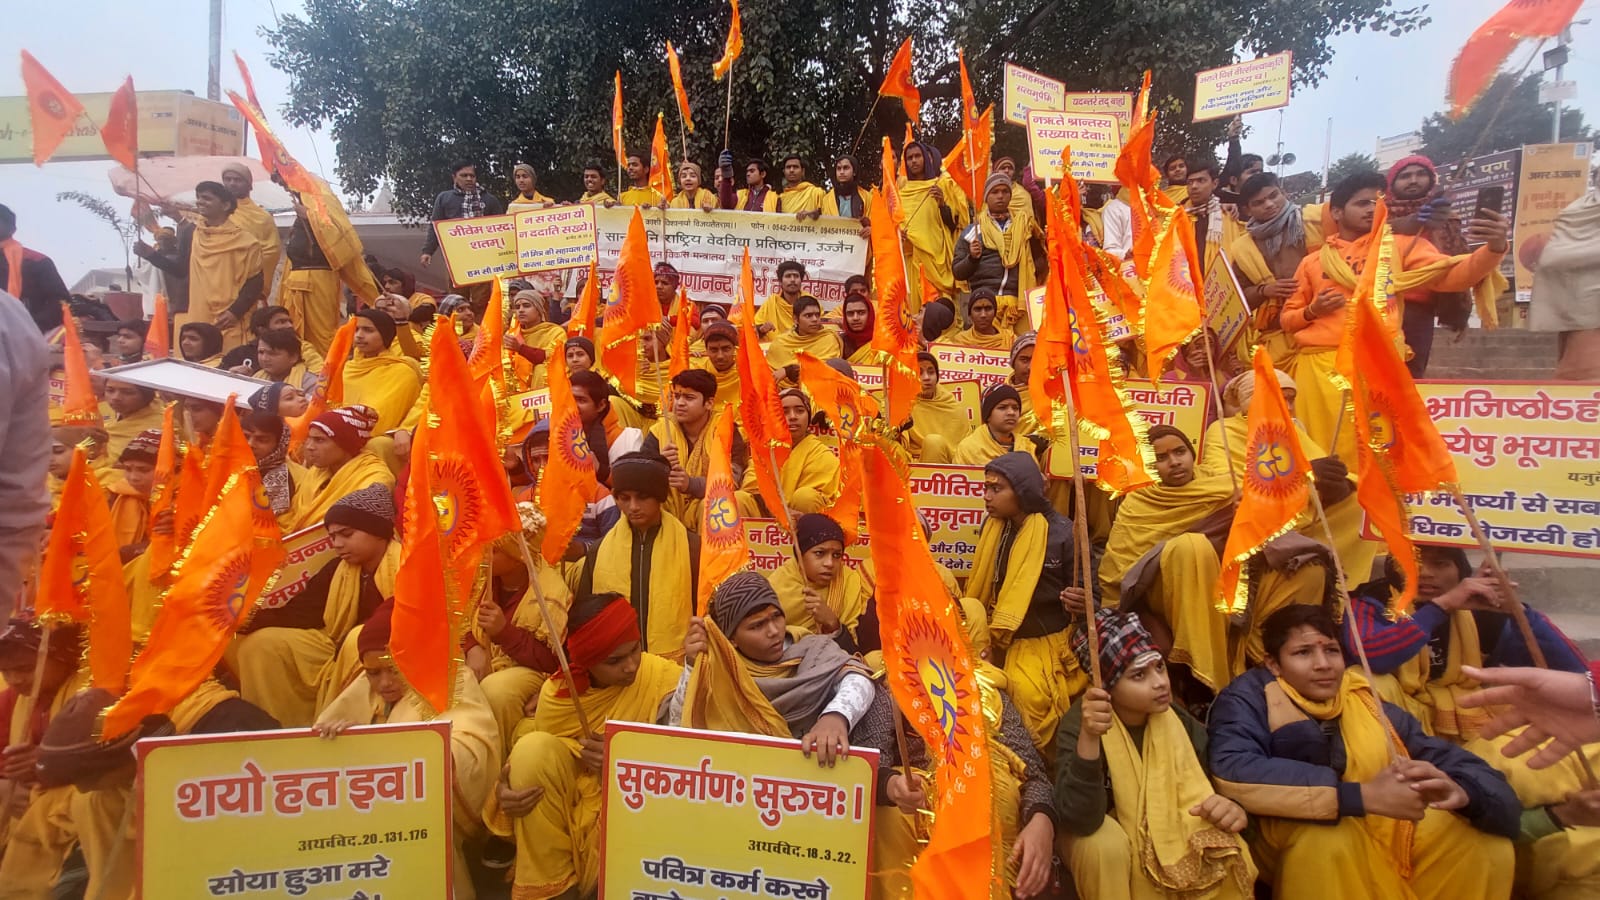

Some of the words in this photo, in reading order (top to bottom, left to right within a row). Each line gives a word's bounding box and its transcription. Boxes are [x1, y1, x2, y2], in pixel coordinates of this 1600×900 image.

[1037, 129, 1078, 139] सख्याय
[448, 224, 484, 237] जीवेम
[816, 240, 854, 254] उज्जैन
[939, 351, 952, 363] न
[954, 350, 966, 363] ते
[1522, 492, 1547, 513] से
[929, 541, 953, 554] और
[177, 761, 267, 819] शयो
[272, 770, 340, 814] हत
[616, 758, 746, 810] सुकर्माणः
[208, 869, 280, 897] सोया
[284, 863, 344, 896] हुआ
[347, 854, 390, 885] मरे
[642, 857, 707, 886] पवित्र
[709, 868, 763, 894] कर्म
[763, 878, 831, 900] करने
